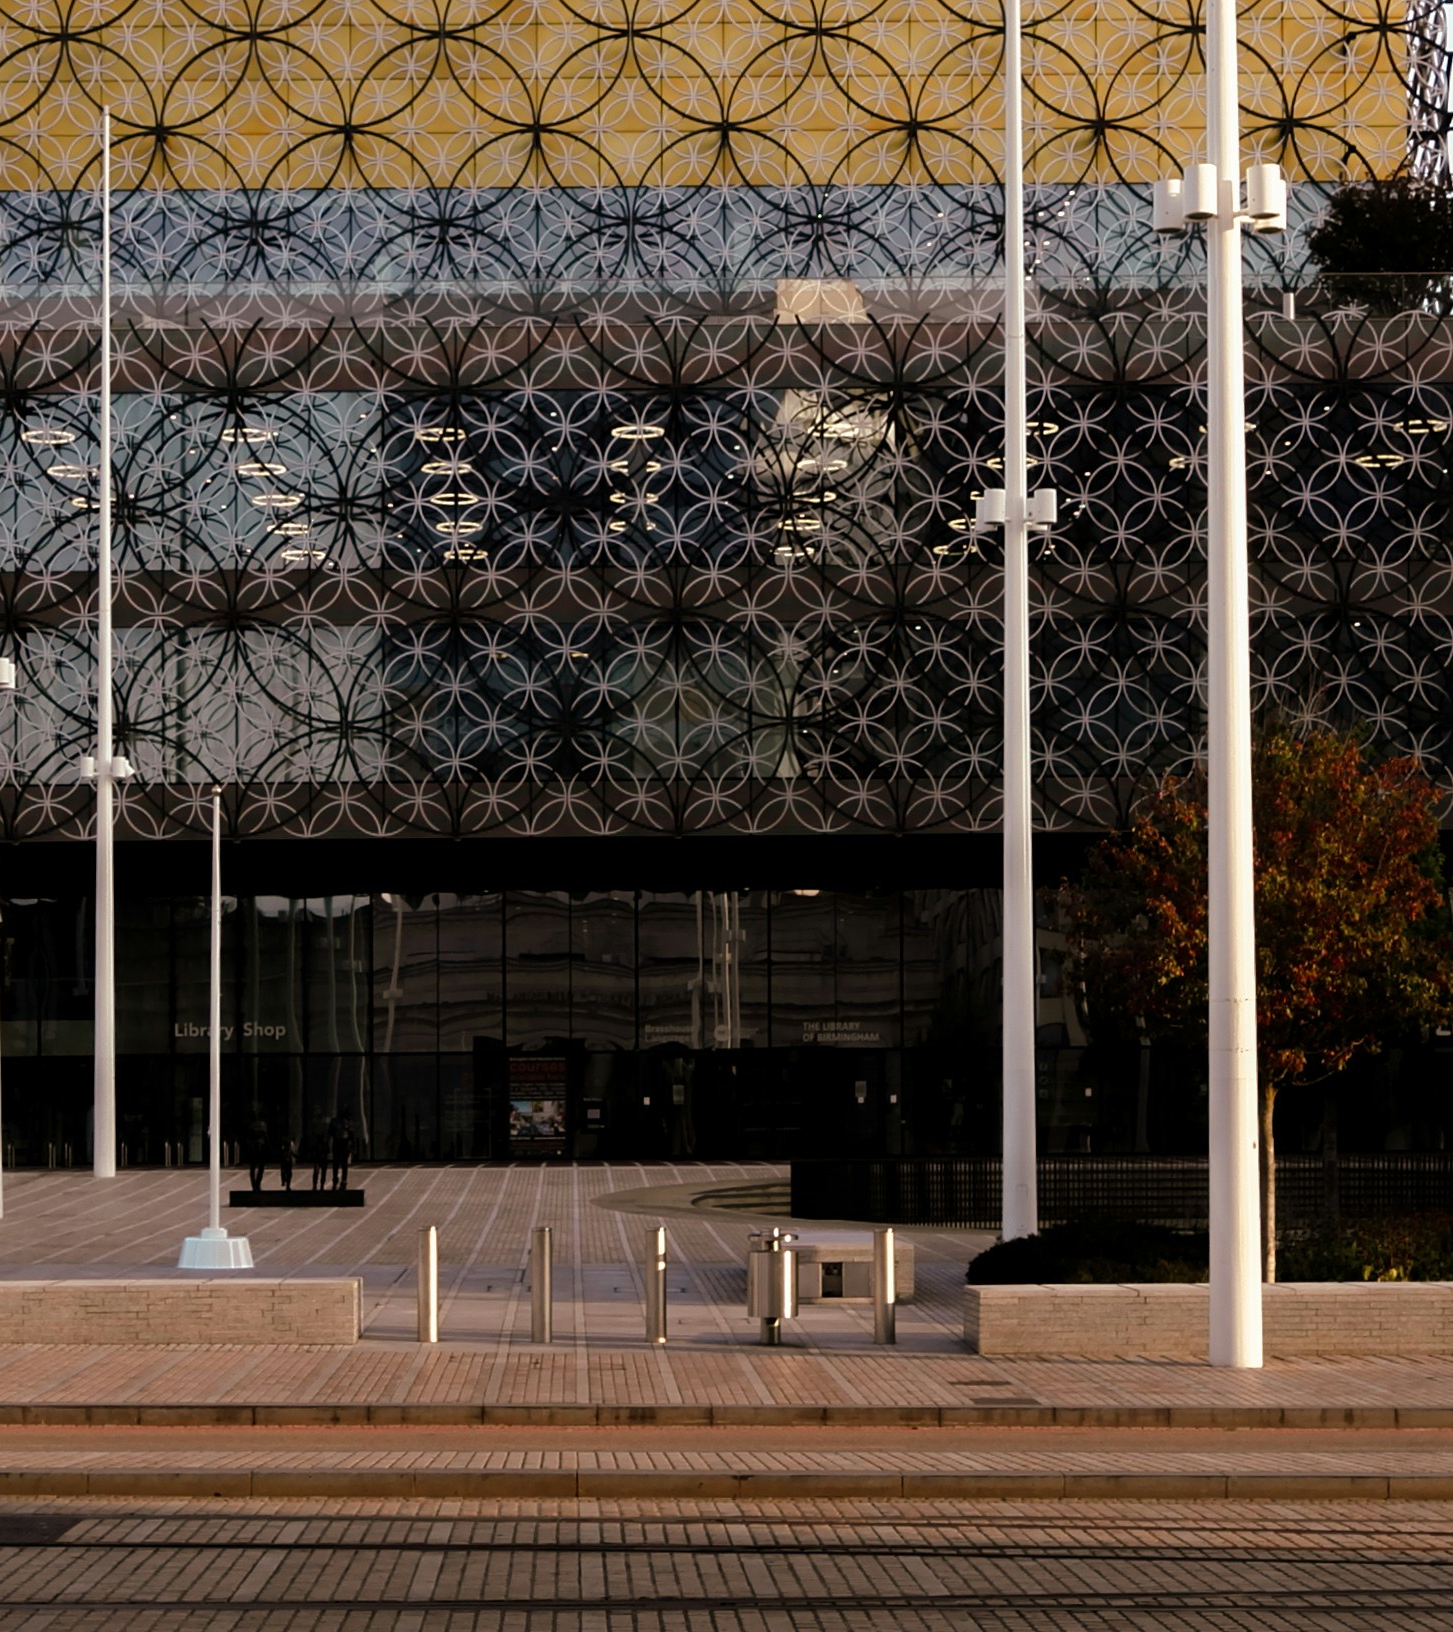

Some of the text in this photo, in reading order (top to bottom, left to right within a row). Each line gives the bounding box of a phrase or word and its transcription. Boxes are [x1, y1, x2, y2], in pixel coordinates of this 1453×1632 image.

[242, 1021, 286, 1040] Shop
[802, 1022, 861, 1031] THE LIBRARY
[802, 1033, 880, 1042] OF BIRMINGHAM
